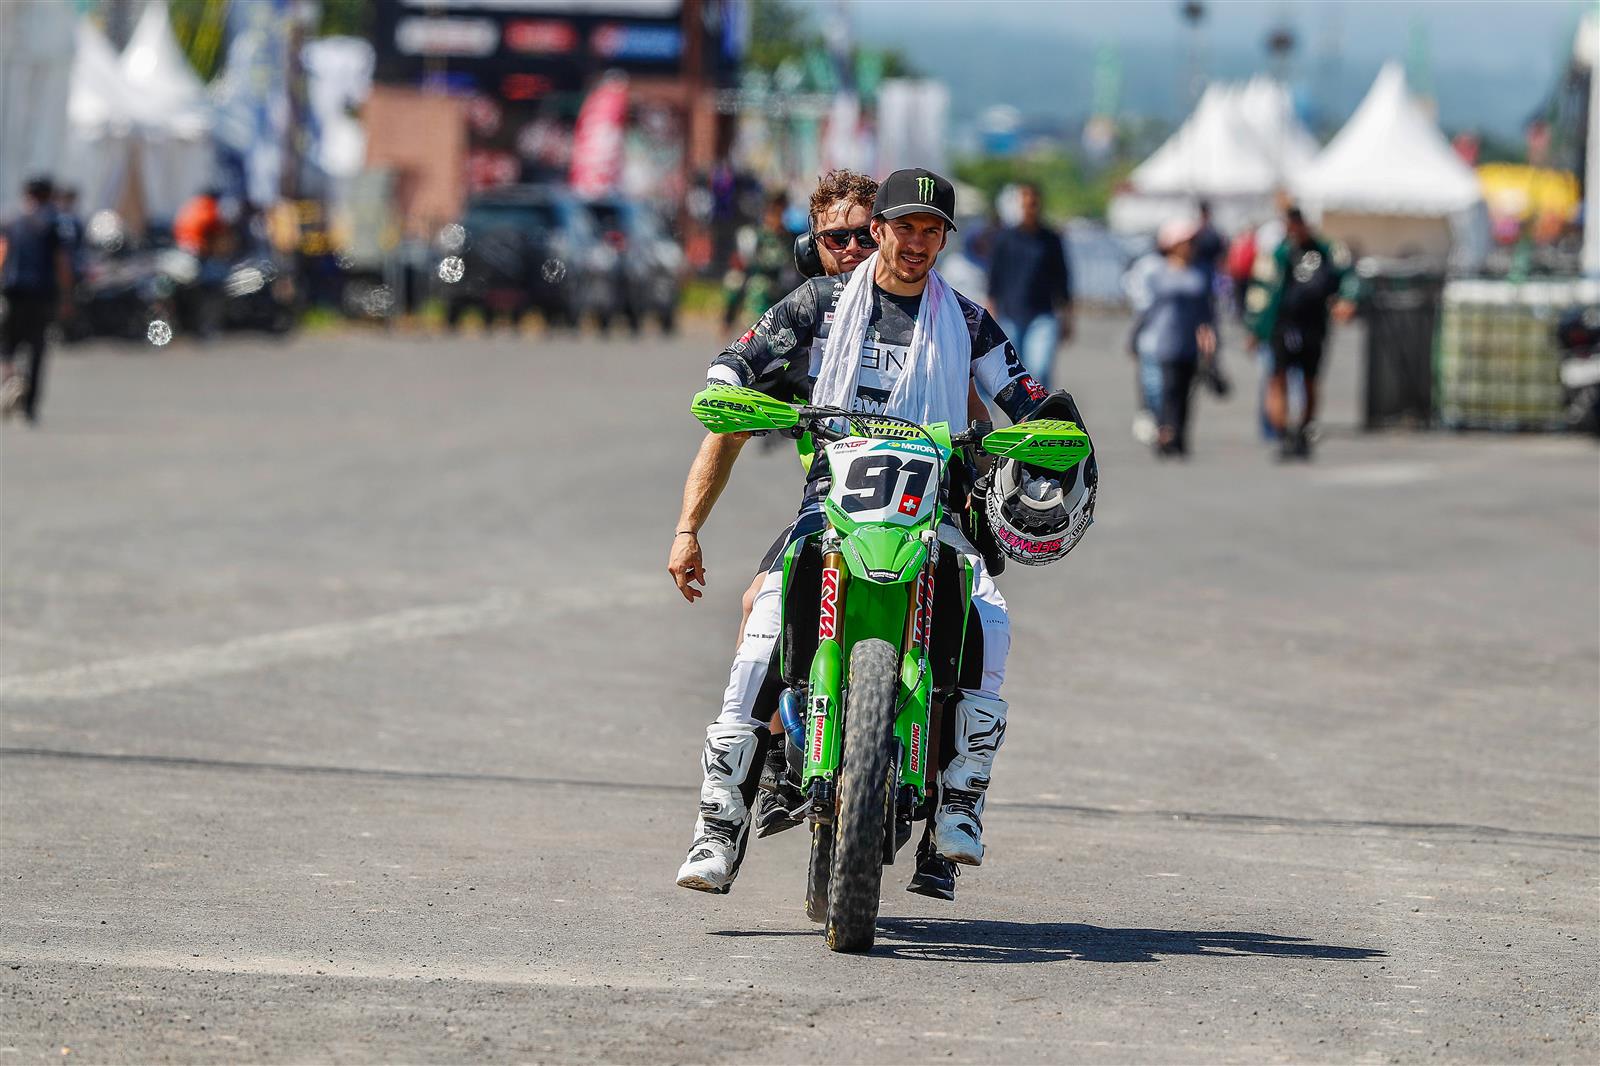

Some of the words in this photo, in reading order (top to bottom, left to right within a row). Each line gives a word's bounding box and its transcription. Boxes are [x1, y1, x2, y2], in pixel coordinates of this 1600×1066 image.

[697, 398, 755, 413] ACERBIS
[1028, 439, 1085, 449] ACERBIS
[841, 455, 934, 514] 91
[999, 526, 1064, 553] SEEWER
[819, 568, 839, 640] KYB
[813, 716, 825, 762] BRAKING
[911, 723, 920, 773] BRAKING
